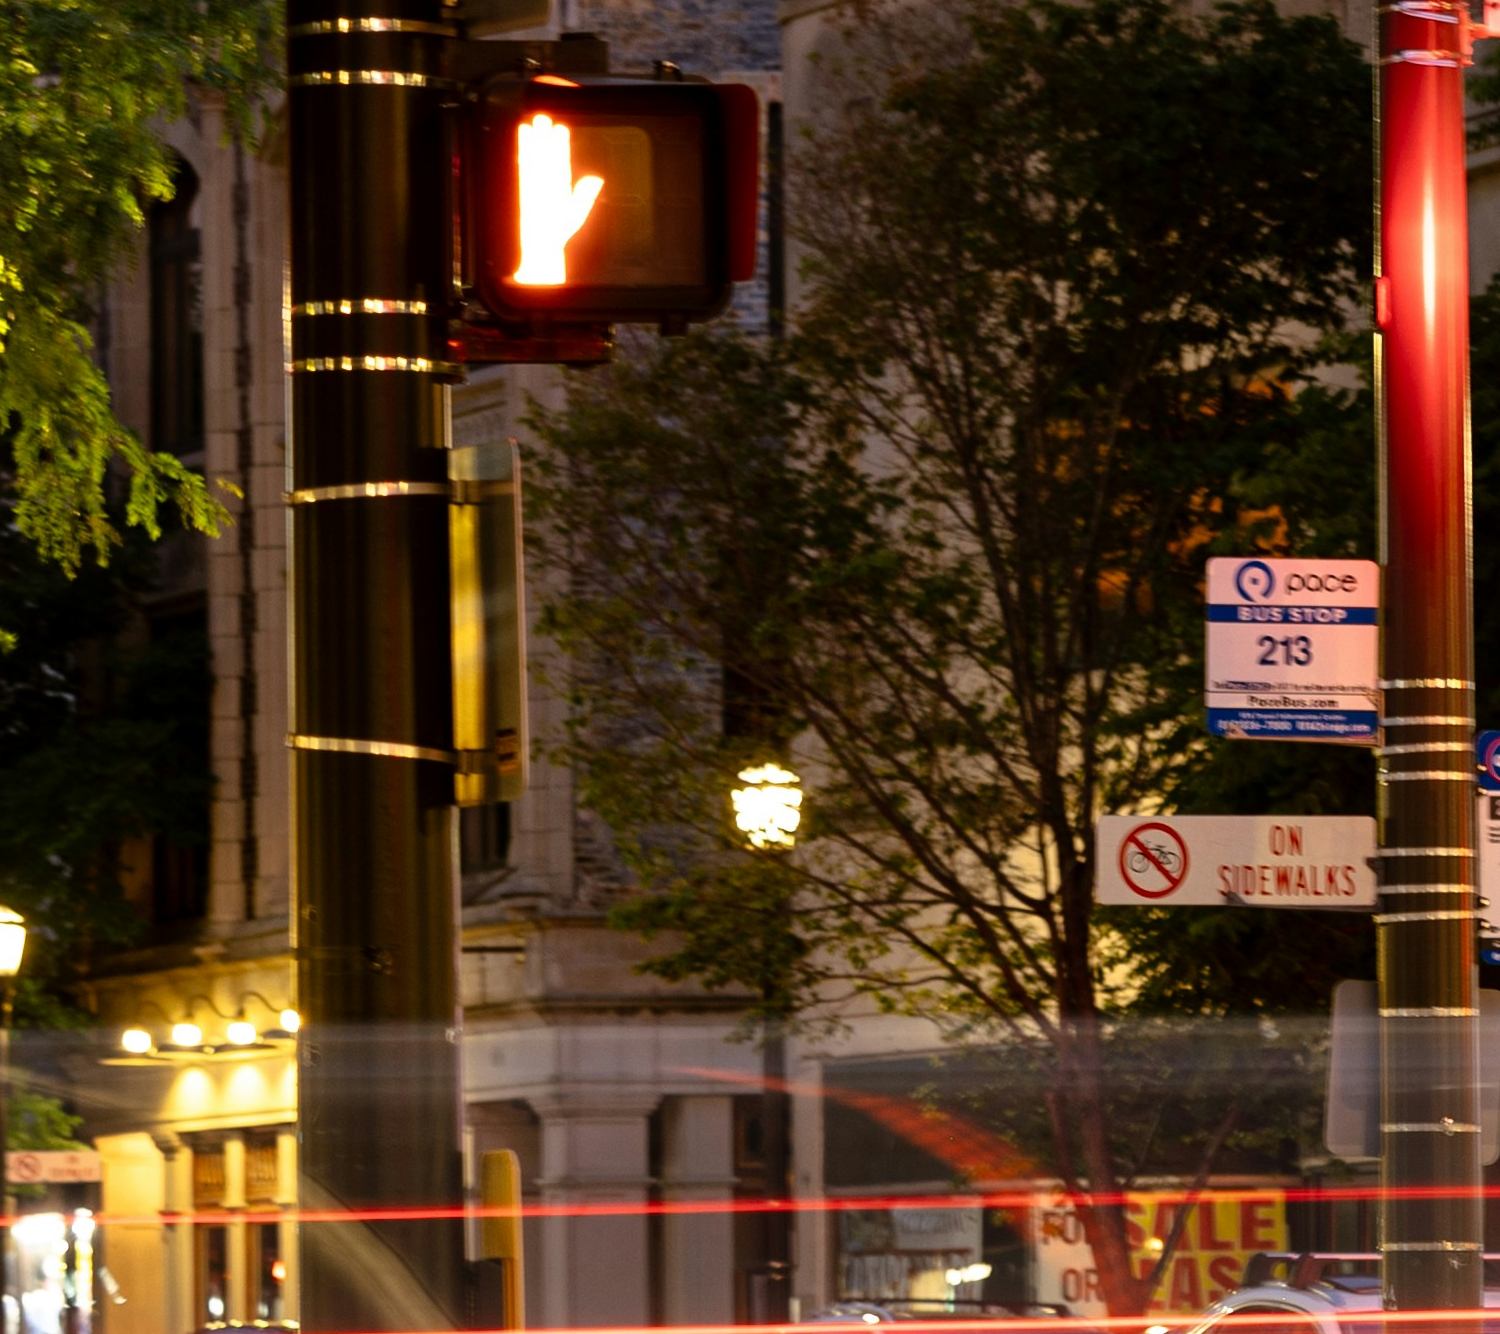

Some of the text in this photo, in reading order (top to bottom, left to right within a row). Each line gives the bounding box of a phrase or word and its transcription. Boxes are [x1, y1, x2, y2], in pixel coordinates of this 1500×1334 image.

[1285, 573, 1358, 596] pace
[1236, 606, 1348, 623] BUS STOP
[1257, 635, 1314, 666] 213
[1268, 824, 1304, 857] ON
[1217, 864, 1357, 897] SIDEWALKS
[1125, 1197, 1278, 1252] SALE
